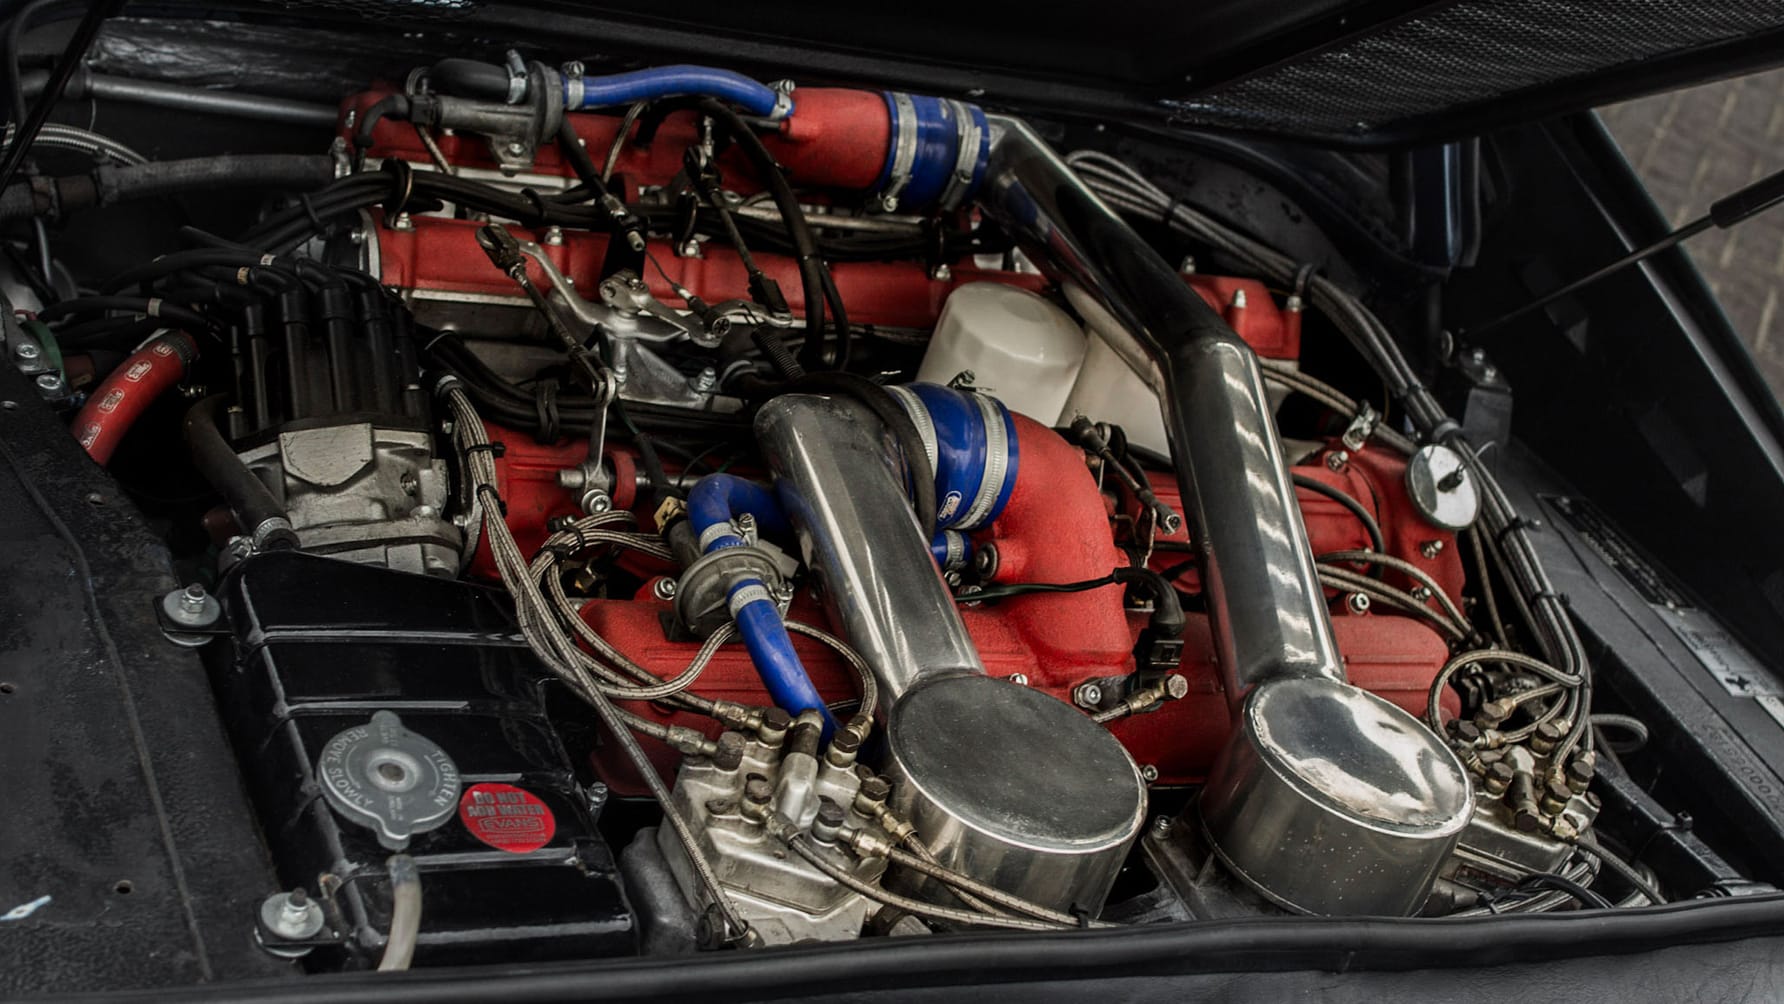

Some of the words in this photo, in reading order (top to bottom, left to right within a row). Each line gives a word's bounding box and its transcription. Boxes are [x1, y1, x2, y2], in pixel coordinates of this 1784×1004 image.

[327, 728, 368, 763] REMOVE
[329, 767, 373, 807] SLOWLY
[431, 750, 457, 806] TIGHTEN
[473, 791, 495, 804] DO
[496, 792, 526, 804] NOT
[467, 805, 496, 817] ADD
[497, 804, 545, 816] WATER
[483, 819, 541, 830] EVANS
